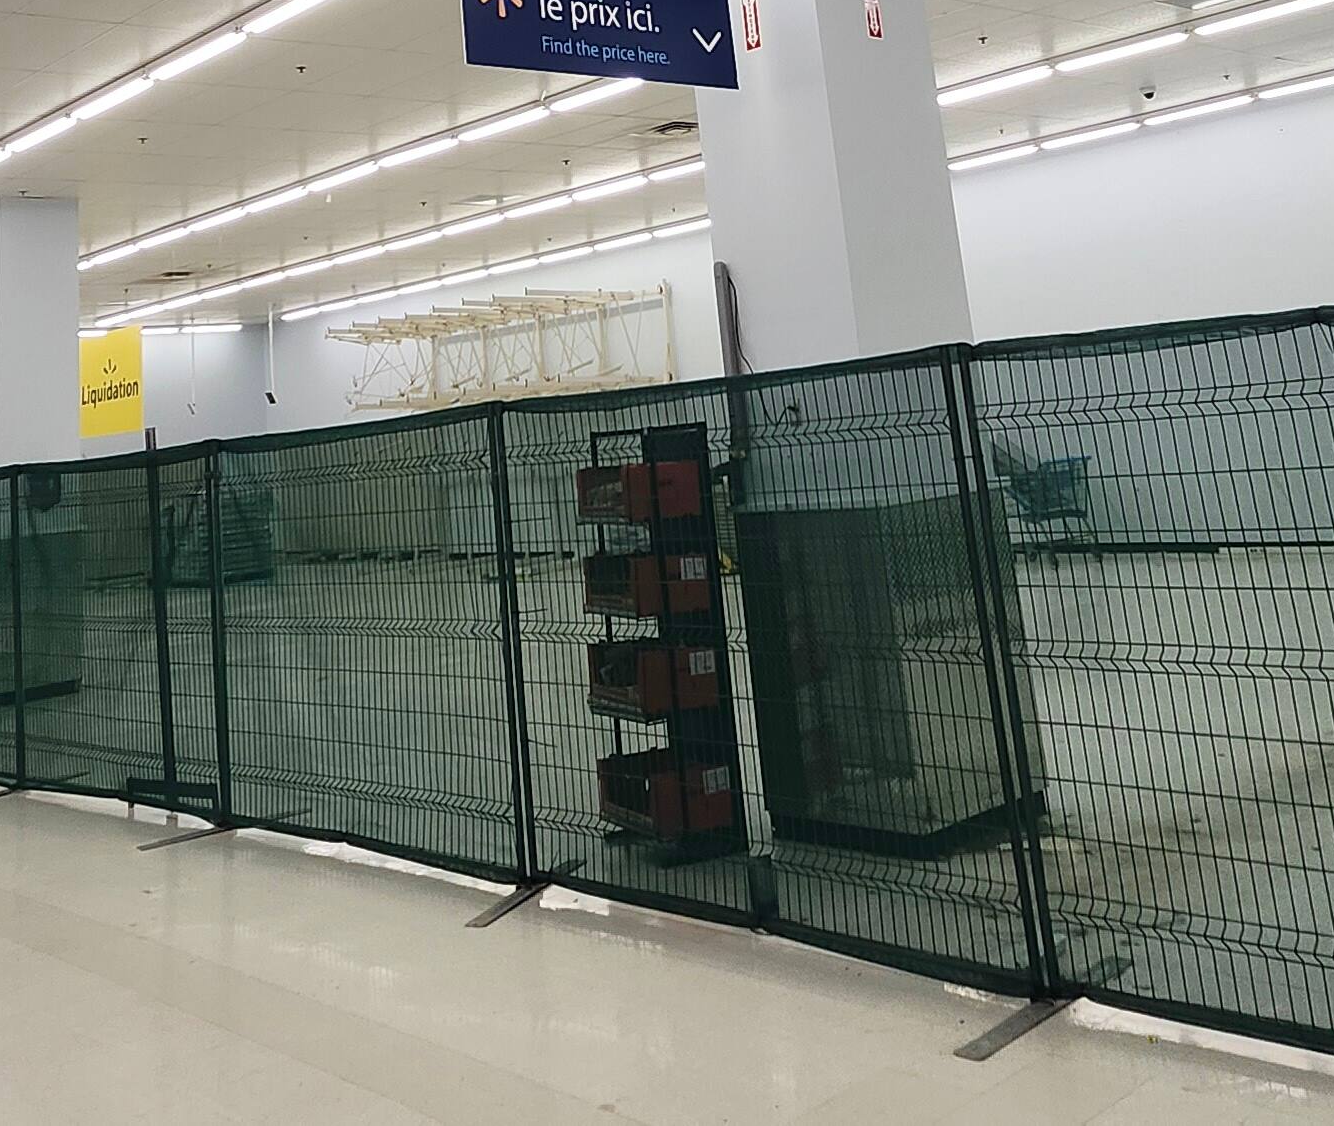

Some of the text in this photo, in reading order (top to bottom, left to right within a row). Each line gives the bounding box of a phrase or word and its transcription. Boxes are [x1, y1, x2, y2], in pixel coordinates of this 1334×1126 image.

[625, 0, 660, 33] ici.
[541, 35, 671, 65] Find the price here.
[81, 377, 139, 409] Liquidation
